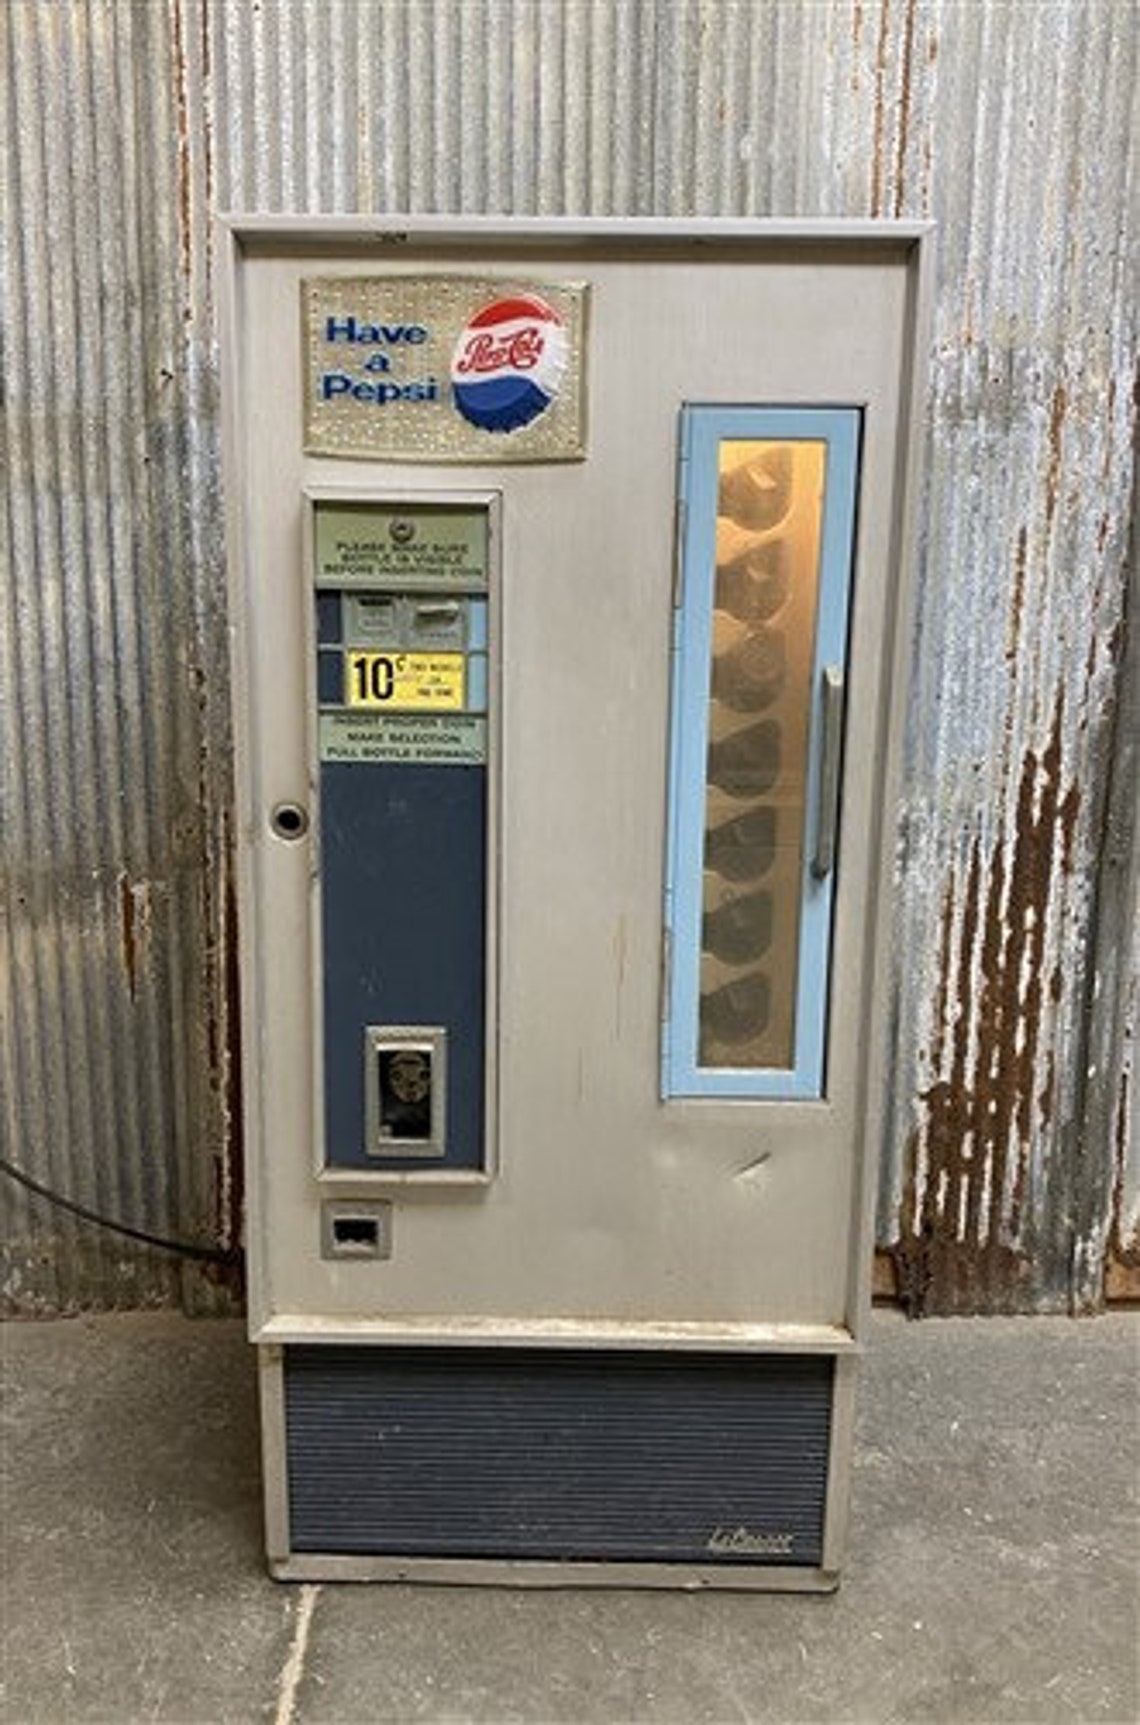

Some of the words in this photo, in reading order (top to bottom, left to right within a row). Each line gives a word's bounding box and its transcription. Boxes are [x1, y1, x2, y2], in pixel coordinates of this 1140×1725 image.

[325, 316, 428, 344] Have
[364, 353, 390, 372] a
[322, 374, 438, 405] Pepsi
[347, 732, 384, 741] MAKE
[389, 733, 462, 743] SELECTION
[327, 747, 358, 757] PULL
[362, 747, 410, 758] BOTTLE
[416, 748, 482, 759] FORWARD
